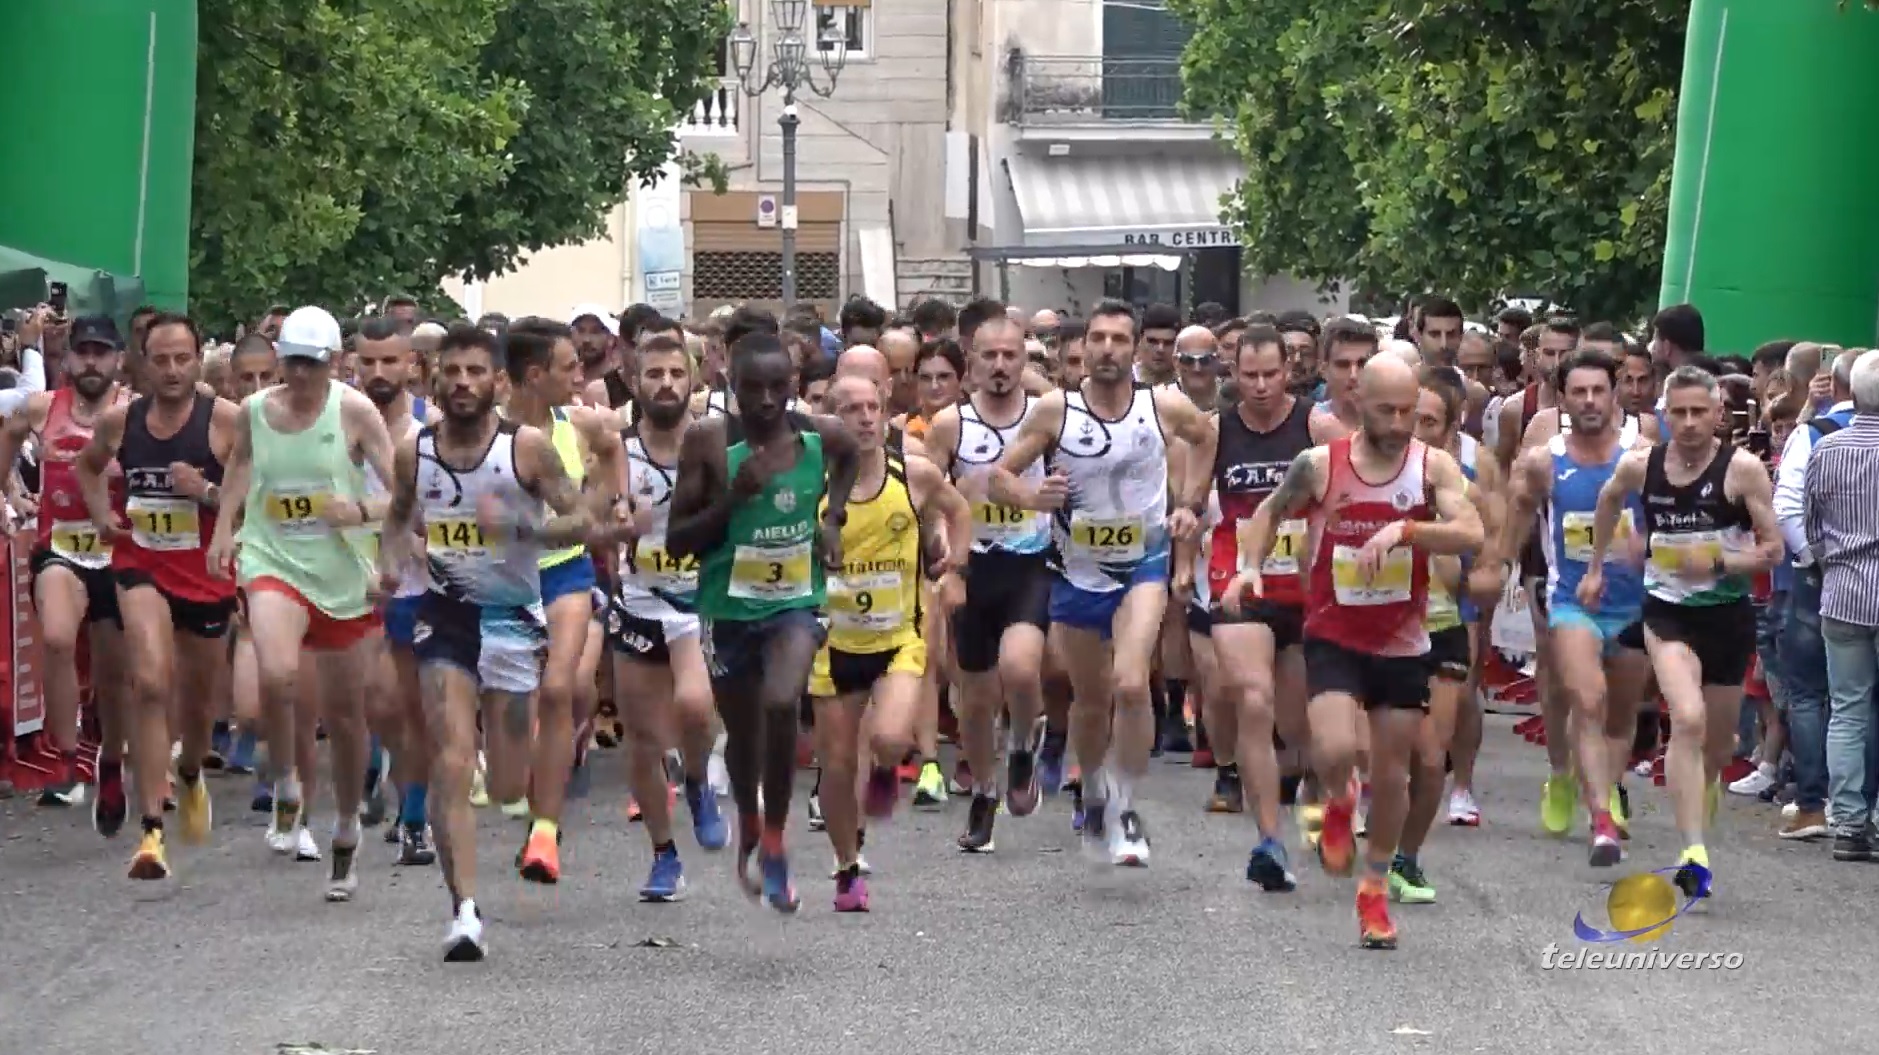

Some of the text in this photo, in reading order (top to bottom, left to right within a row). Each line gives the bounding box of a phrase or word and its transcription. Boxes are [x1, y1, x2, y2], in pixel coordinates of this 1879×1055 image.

[1125, 231, 1239, 245] BAR CENTR
[279, 496, 313, 518] 19
[147, 513, 172, 533] 11
[68, 533, 96, 552] 17
[1086, 526, 1133, 546] 126
[765, 562, 783, 583] 3
[856, 591, 873, 614] 9
